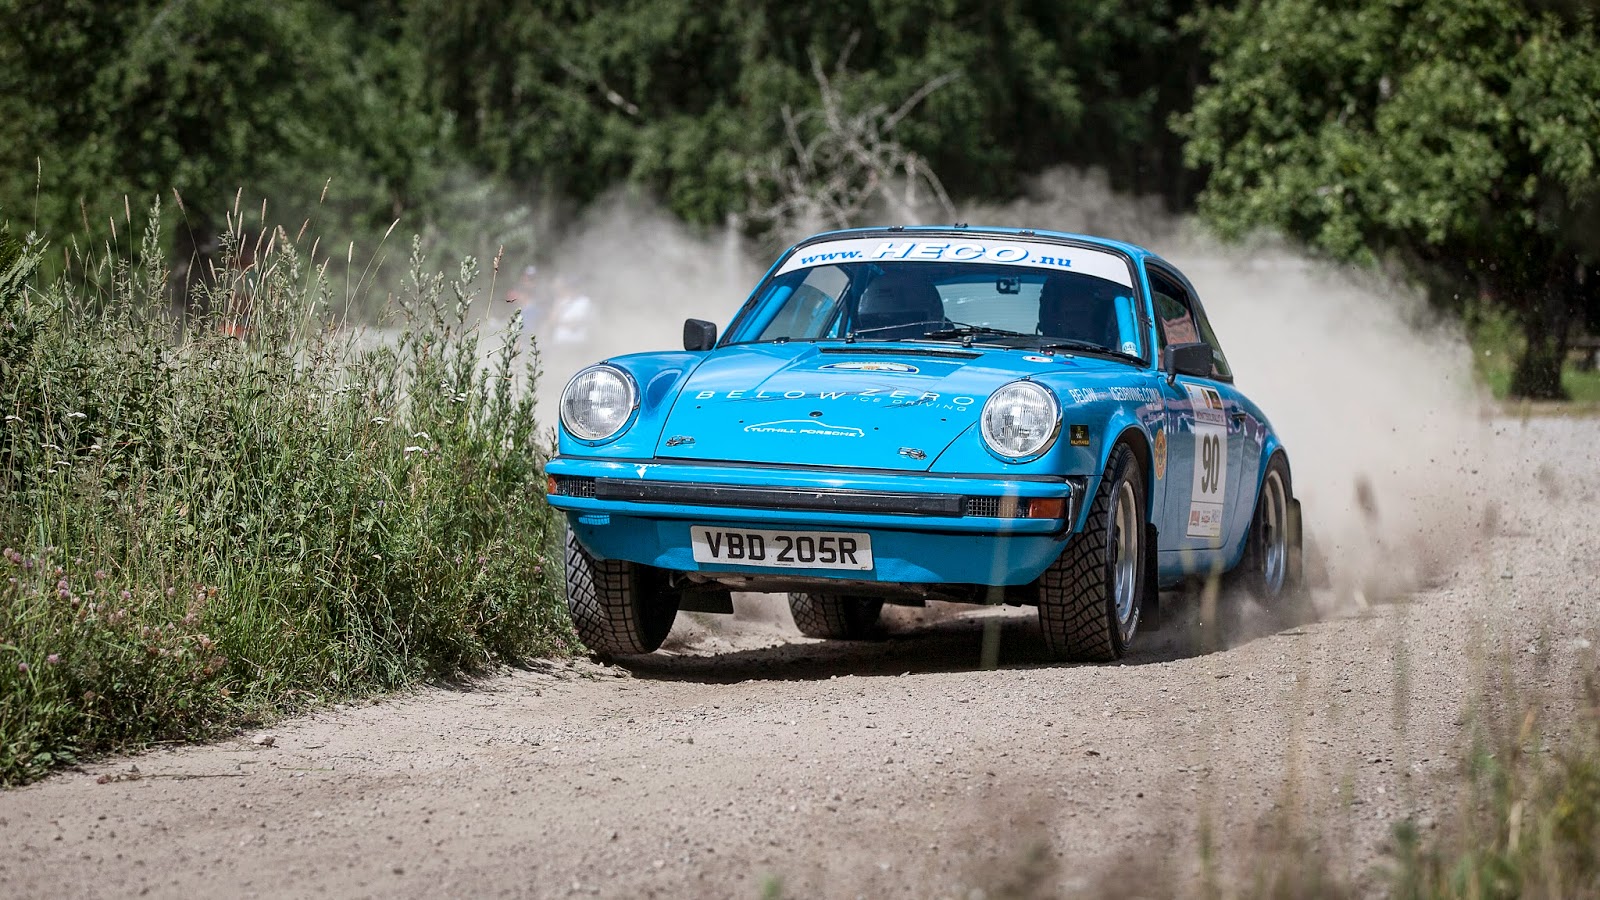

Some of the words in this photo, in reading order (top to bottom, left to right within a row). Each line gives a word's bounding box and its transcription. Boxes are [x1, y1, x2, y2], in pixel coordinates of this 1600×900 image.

[892, 399, 968, 412] DRIVING
[800, 429, 858, 438] PORSCHE
[1201, 433, 1220, 494] 90
[704, 531, 766, 561] VBD
[774, 535, 858, 565] 205R
